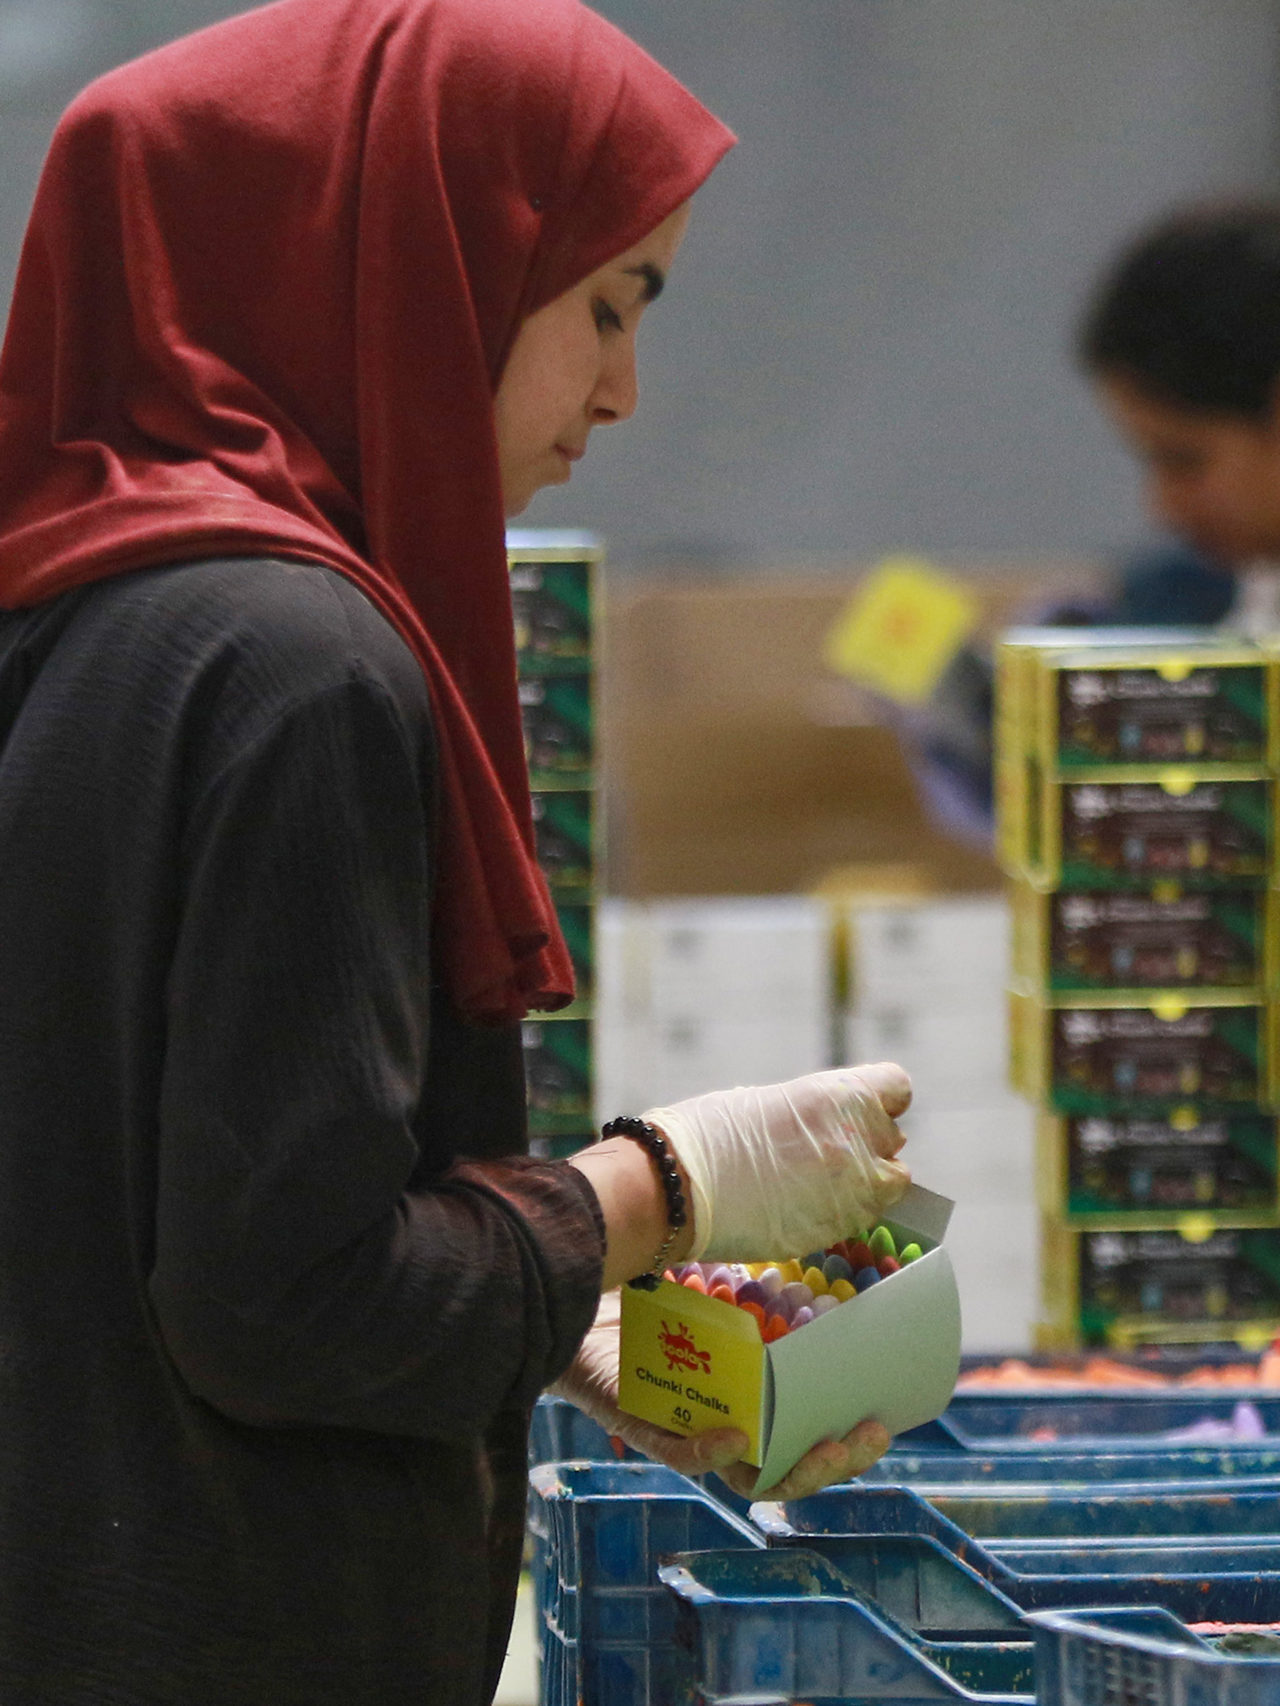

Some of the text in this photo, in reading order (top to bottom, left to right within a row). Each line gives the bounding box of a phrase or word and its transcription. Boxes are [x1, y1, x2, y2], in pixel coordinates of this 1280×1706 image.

[636, 1367, 730, 1415] Chunki Chalks
[673, 1406, 692, 1423] 40
